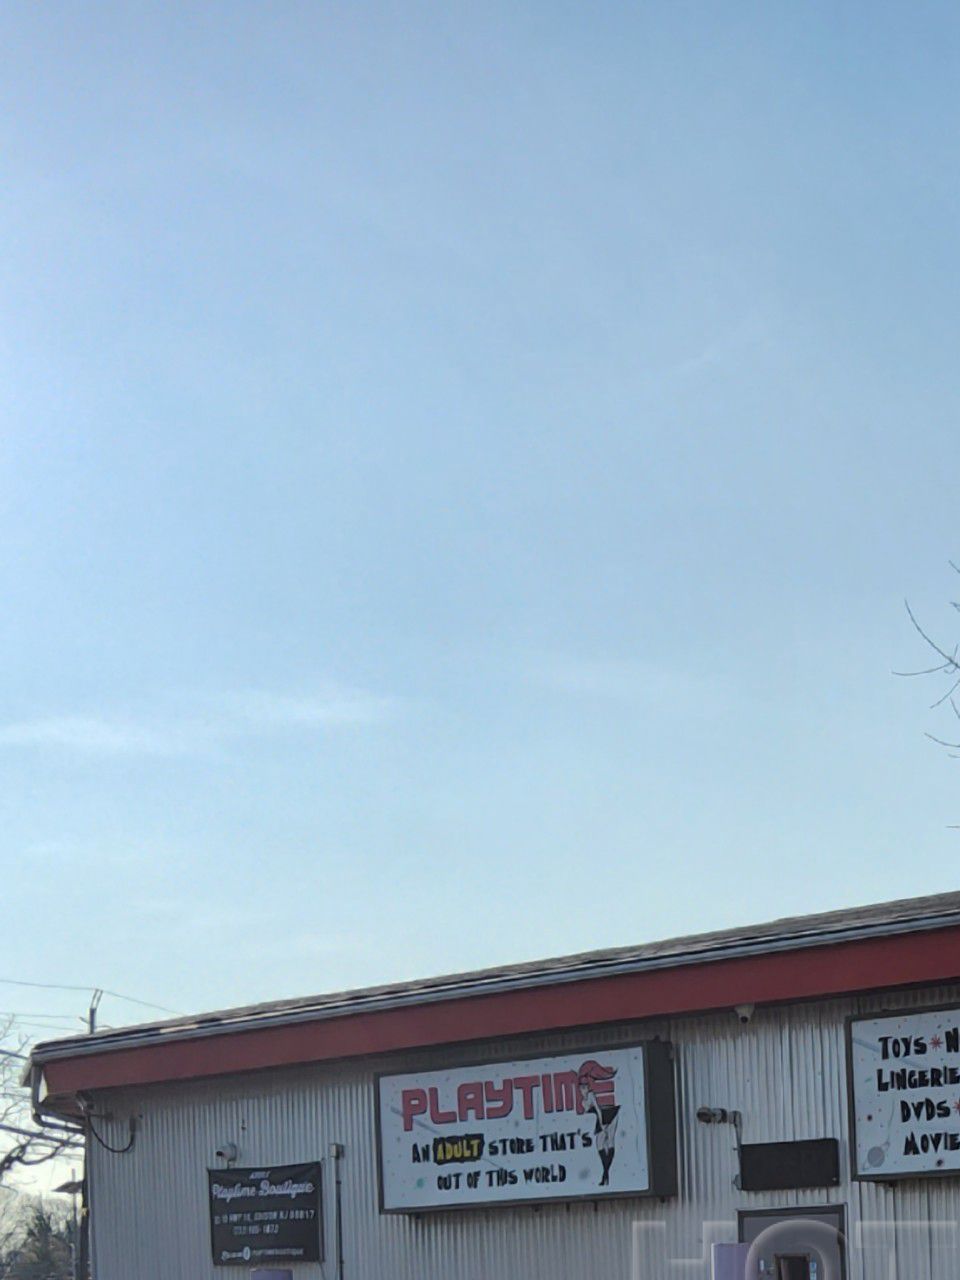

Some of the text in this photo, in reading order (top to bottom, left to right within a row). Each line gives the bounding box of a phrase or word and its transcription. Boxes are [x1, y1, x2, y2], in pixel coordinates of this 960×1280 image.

[878, 1035, 927, 1060] TOYS
[876, 1065, 960, 1092] LINGERIE
[402, 1071, 615, 1132] PLAYTIME
[900, 1099, 951, 1123] DVDS
[436, 1137, 481, 1161] ADULT
[488, 1136, 534, 1156] STORE
[539, 1128, 592, 1151] THAT'S
[903, 1131, 960, 1155] MOVIE
[259, 1180, 315, 1199] Boutique
[437, 1164, 566, 1190] OUT OF THIS WORLD
